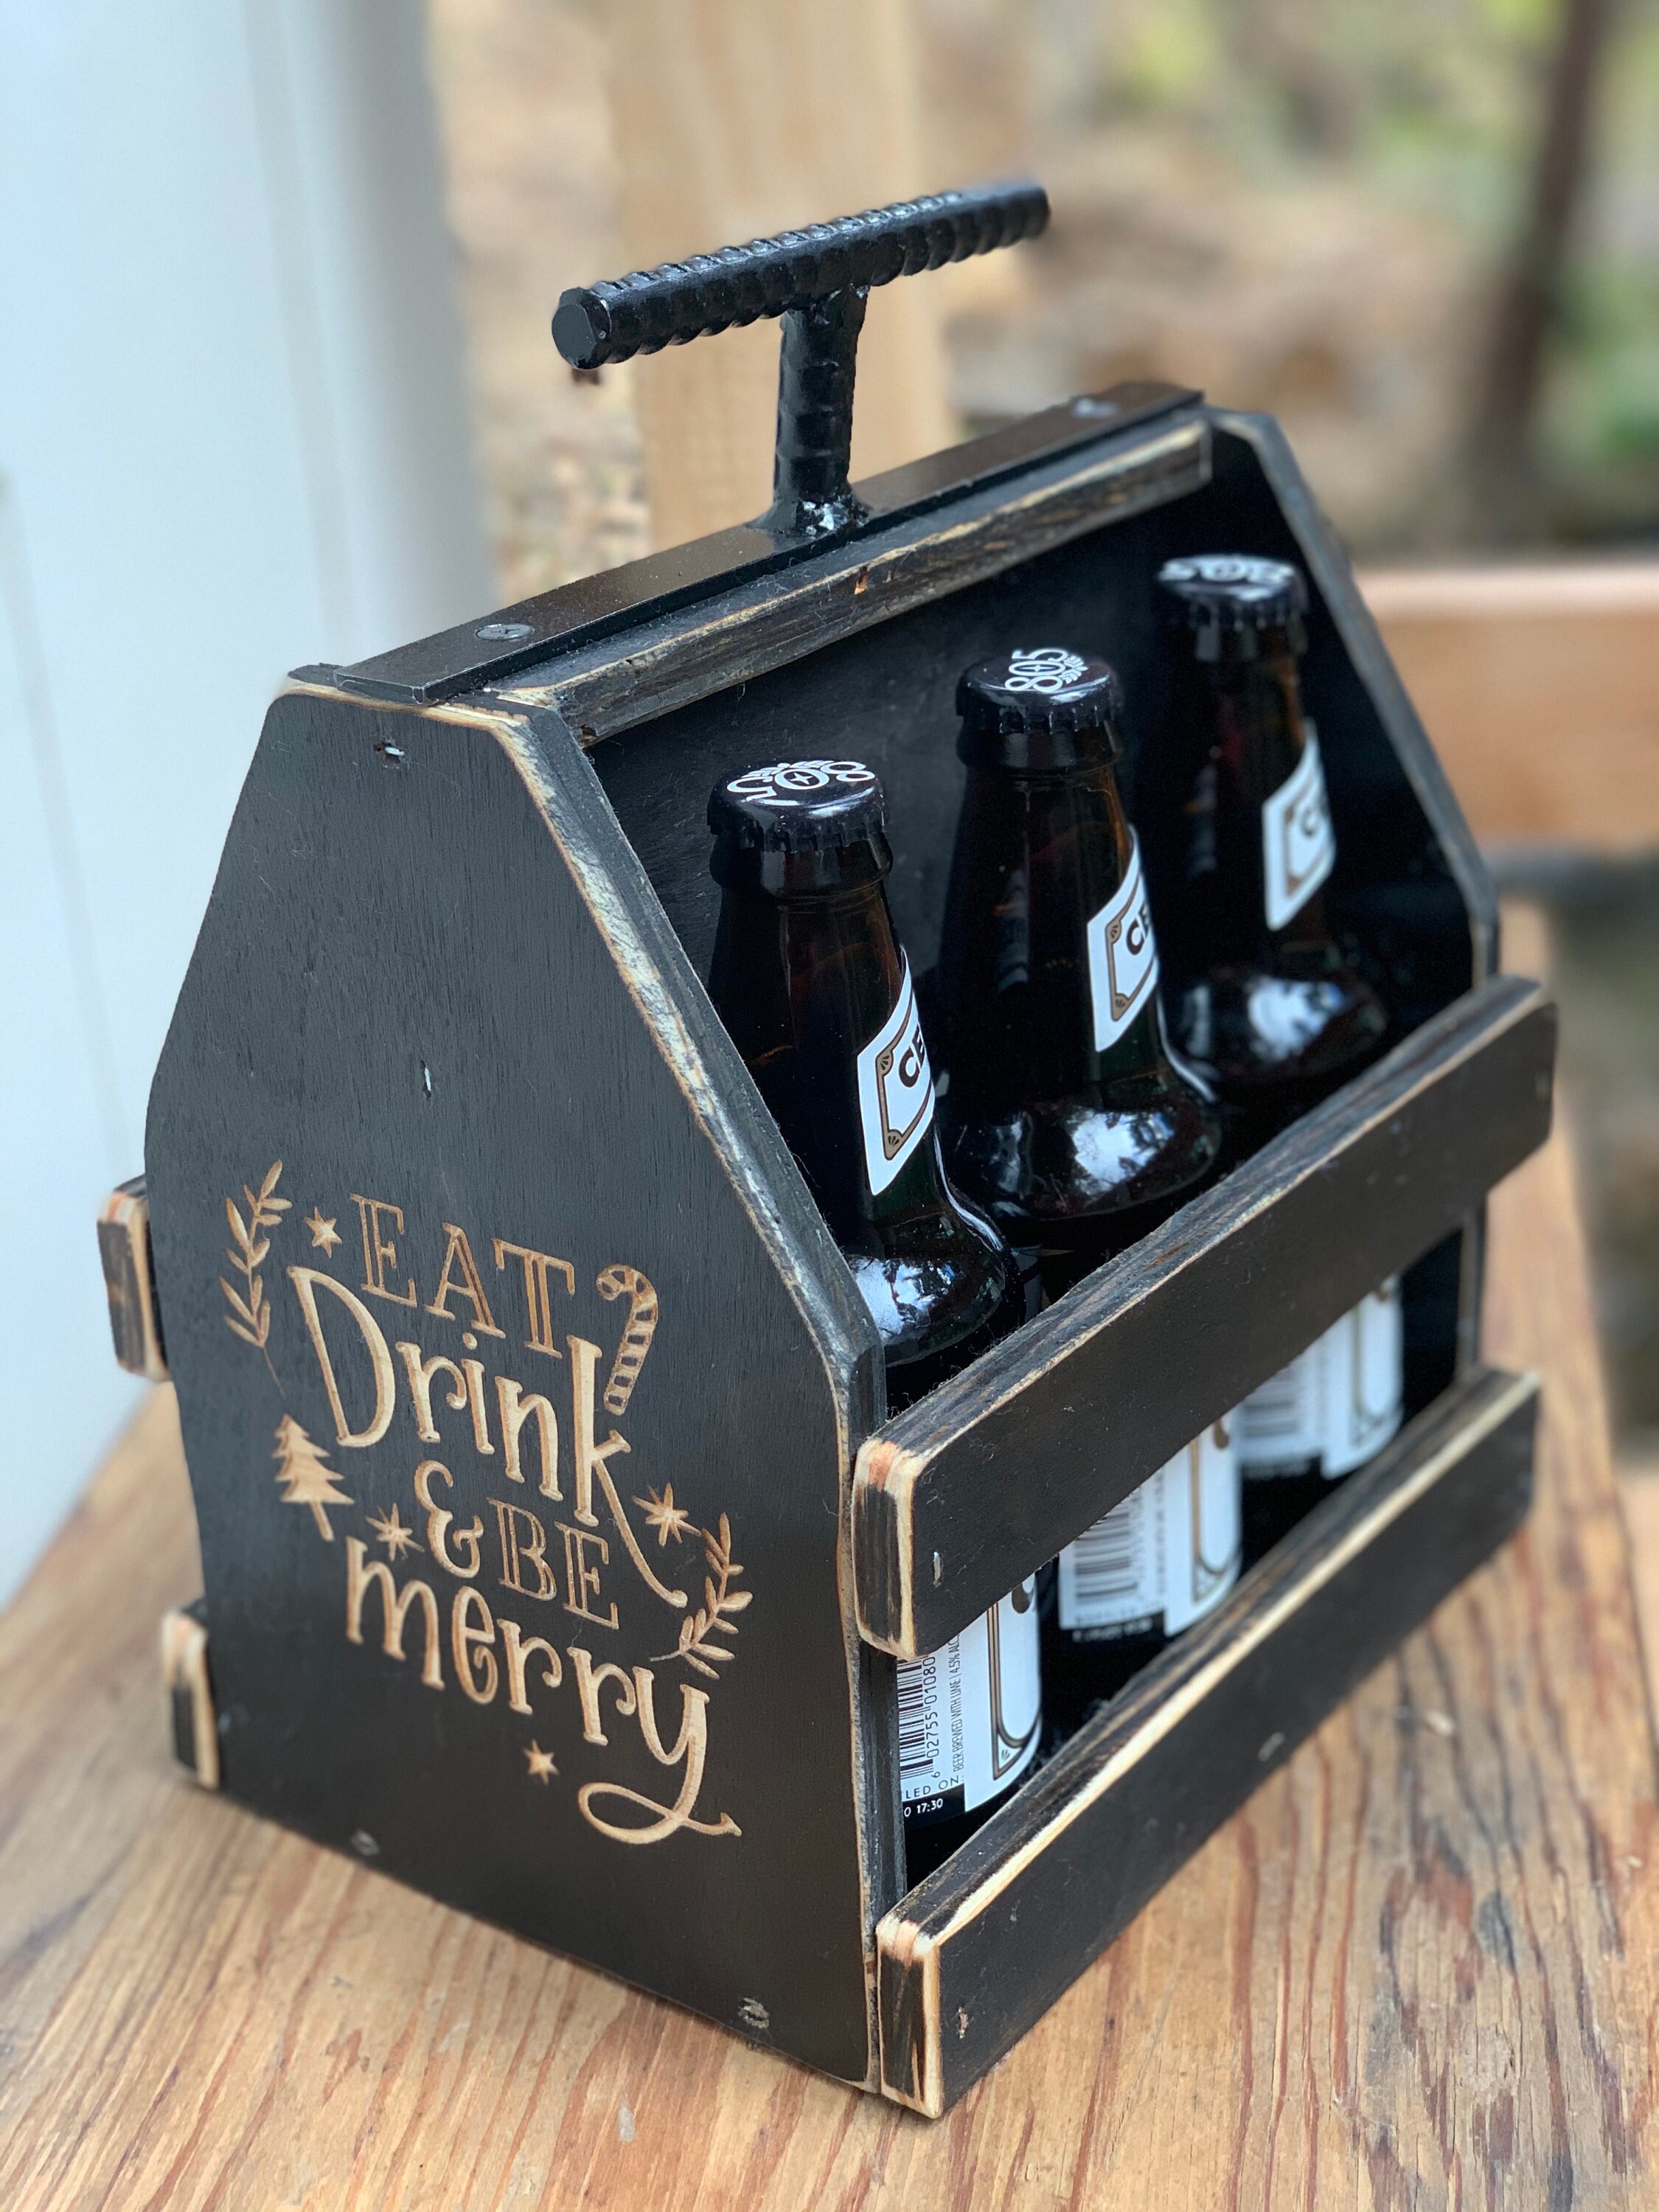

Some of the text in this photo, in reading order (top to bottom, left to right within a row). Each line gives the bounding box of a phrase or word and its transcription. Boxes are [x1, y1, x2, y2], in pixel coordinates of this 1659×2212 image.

[1005, 648, 1068, 693] 805
[726, 760, 875, 802] 805
[349, 1193, 574, 1359] EAT
[286, 1265, 688, 1608] Drink
[414, 1459, 619, 1630] & BE
[345, 1536, 742, 1845] merry
[900, 1785, 931, 1800] LED
[917, 1798, 943, 1814] 17:30
